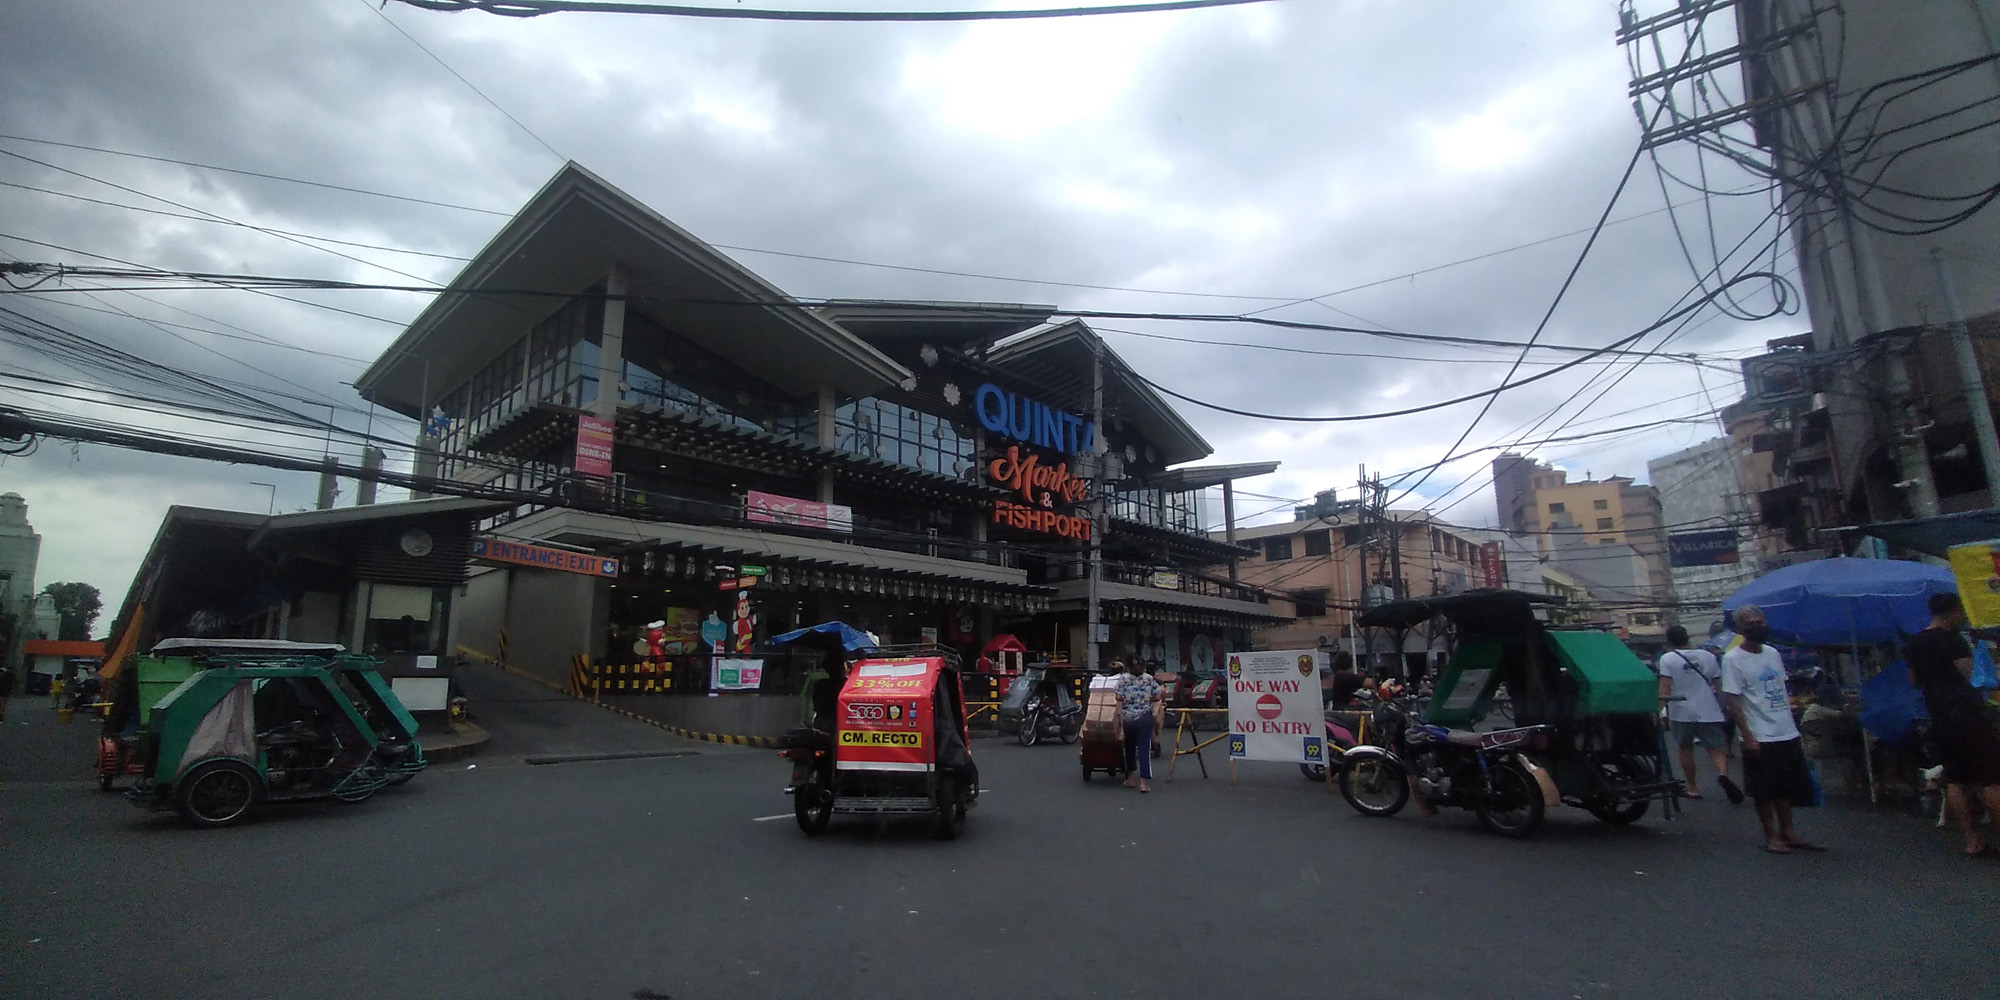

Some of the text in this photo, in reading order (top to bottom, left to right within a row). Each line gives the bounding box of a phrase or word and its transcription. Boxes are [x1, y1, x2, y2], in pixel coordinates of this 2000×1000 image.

[1041, 491, 1053, 508] &
[852, 679, 894, 688] 33%
[1235, 680, 1300, 692] ONE WAY
[847, 703, 884, 719] SOGO
[1235, 720, 1312, 734] NO ENTRY
[842, 732, 918, 744] CM. RECTO
[1232, 741, 1243, 752] 99
[1306, 744, 1319, 756] 99
